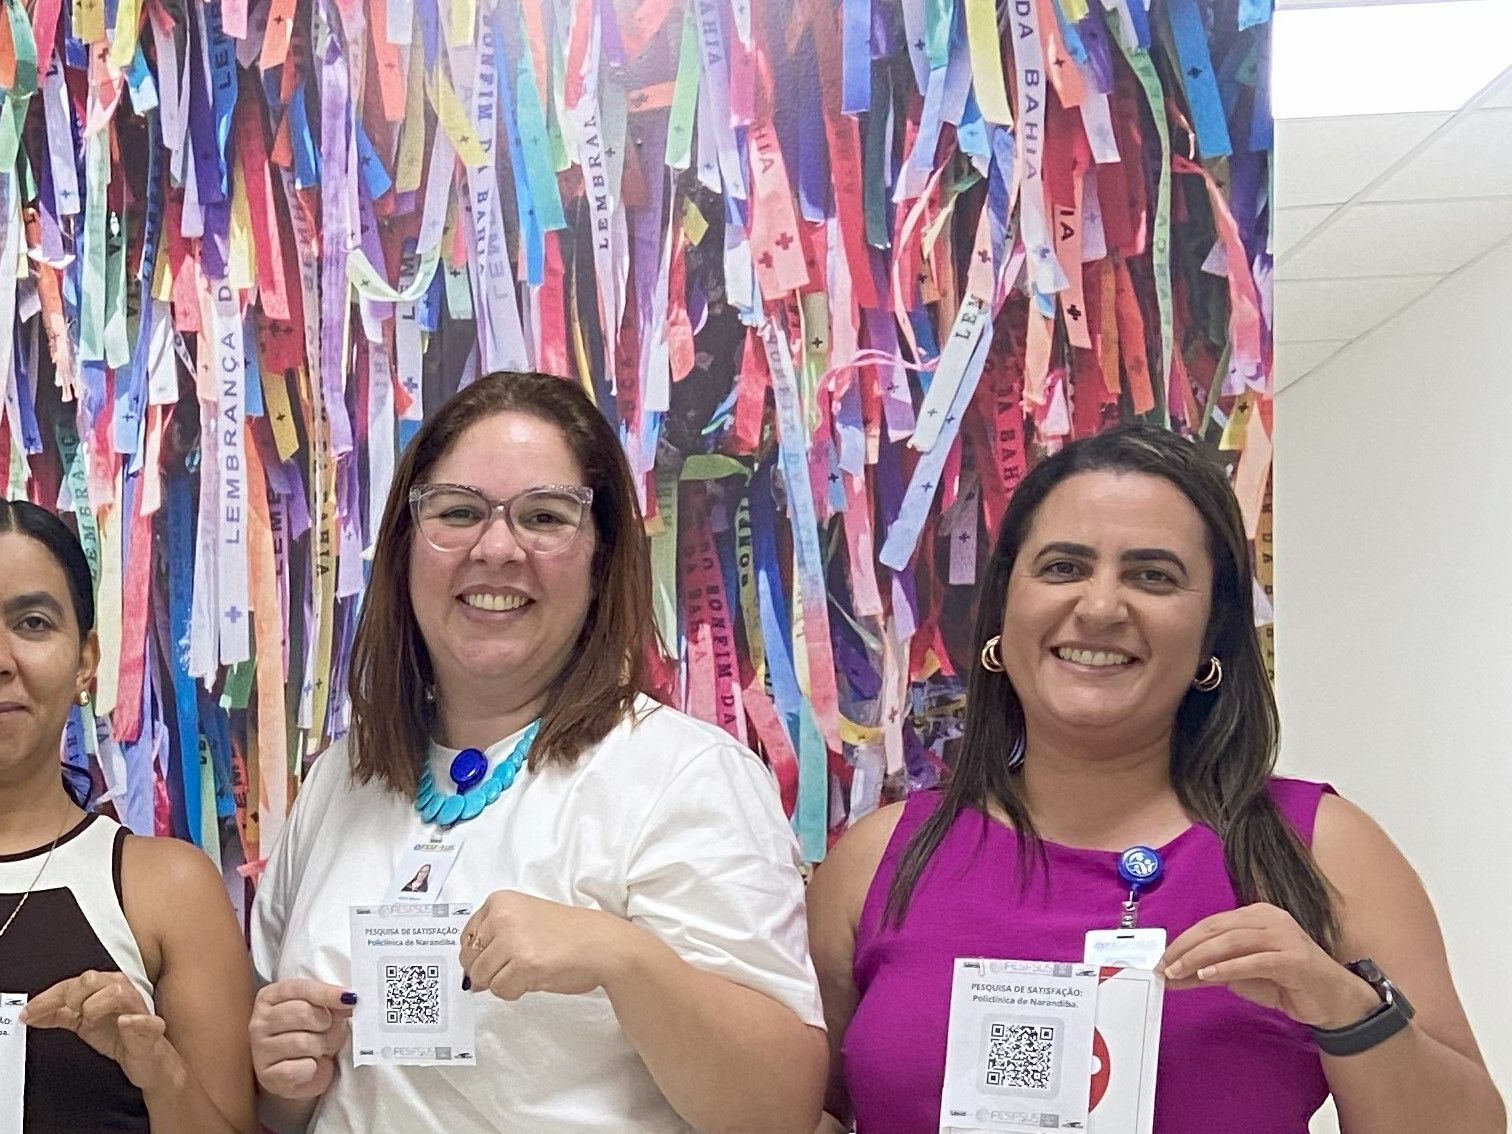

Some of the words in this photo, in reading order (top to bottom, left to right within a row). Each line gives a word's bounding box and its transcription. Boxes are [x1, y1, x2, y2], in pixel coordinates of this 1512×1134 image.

[1015, 1, 1035, 39] DA
[1023, 67, 1042, 180] BAHIA
[220, 330, 243, 545] LEMBRANÇA
[719, 693, 735, 726] DA
[971, 982, 1013, 994] PESQUISA
[1013, 984, 1026, 994] DE
[1016, 997, 1029, 1006] de
